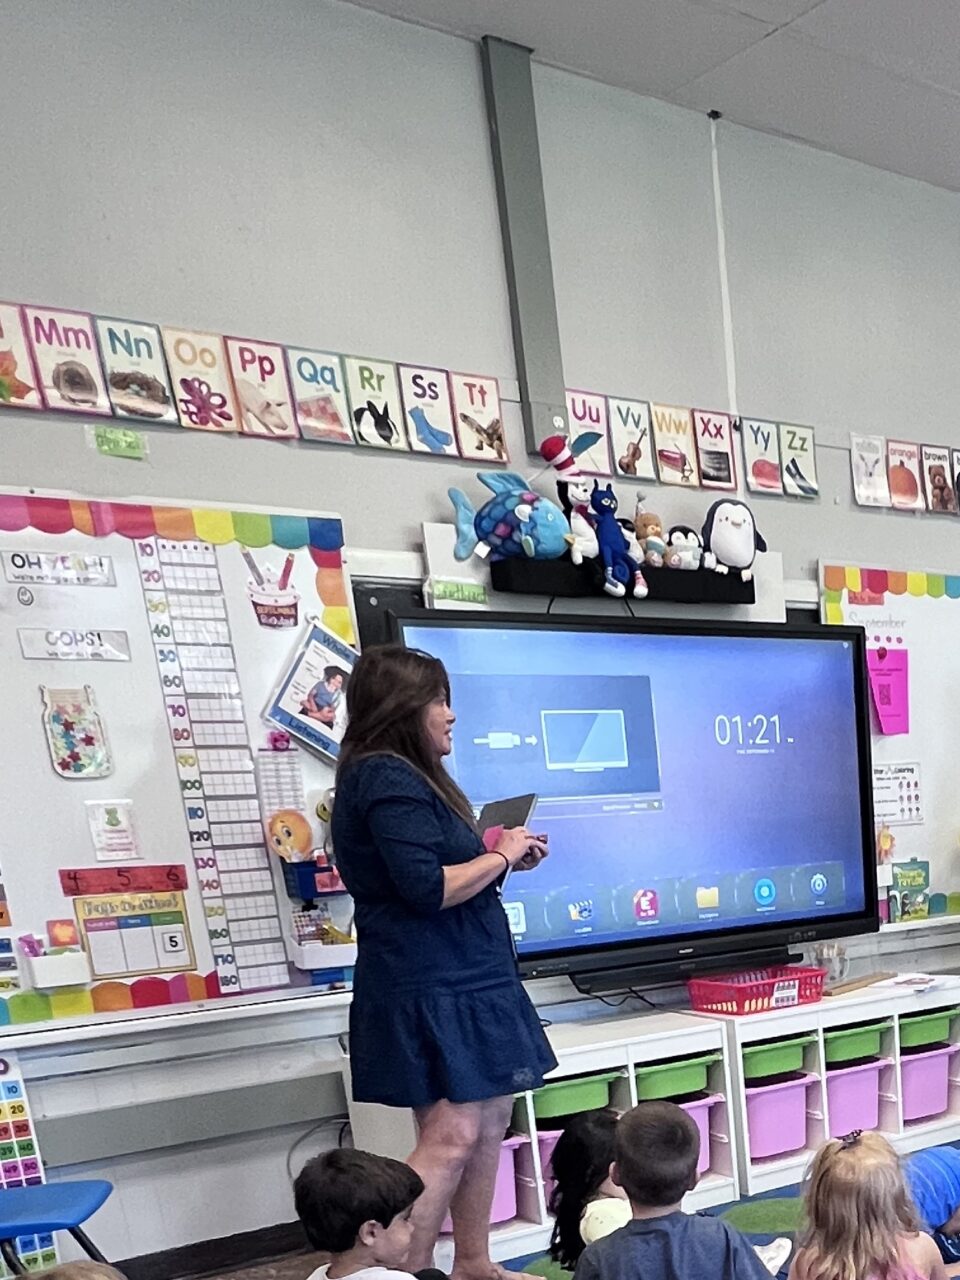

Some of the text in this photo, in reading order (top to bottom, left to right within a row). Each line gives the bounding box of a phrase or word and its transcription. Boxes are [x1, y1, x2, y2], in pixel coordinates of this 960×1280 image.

[34, 316, 91, 350] Mm
[107, 327, 153, 359] Nn
[174, 338, 216, 369] Oo
[238, 347, 275, 382] Pp
[296, 356, 340, 393] Qq
[359, 365, 385, 392] Rr
[411, 374, 440, 400] Ss
[463, 382, 488, 408] Tt
[571, 398, 601, 424] Uu
[617, 404, 642, 430] Vv
[654, 410, 688, 436] Ww
[700, 416, 725, 441] Xx
[749, 424, 771, 451] Yy
[786, 430, 808, 452] Zz
[890, 448, 916, 461] orange
[924, 451, 948, 462] brown
[138, 542, 154, 557] 10
[11, 553, 42, 569] OH
[142, 570, 161, 583] 20
[153, 624, 170, 637] 40
[163, 675, 182, 688] 60
[167, 704, 186, 718] 70
[173, 728, 191, 741] 80
[288, 717, 331, 751] Listening
[715, 714, 780, 745] 01:21
[189, 831, 210, 843] 120
[195, 857, 216, 869] 130
[67, 866, 180, 893] 4 5 6
[169, 935, 178, 948] 5
[7, 1085, 18, 1094] 10
[10, 1104, 24, 1114] 20
[15, 1123, 29, 1133] 30
[20, 1143, 33, 1152] 40
[4, 1164, 18, 1173] 49
[24, 1161, 37, 1171] 50
